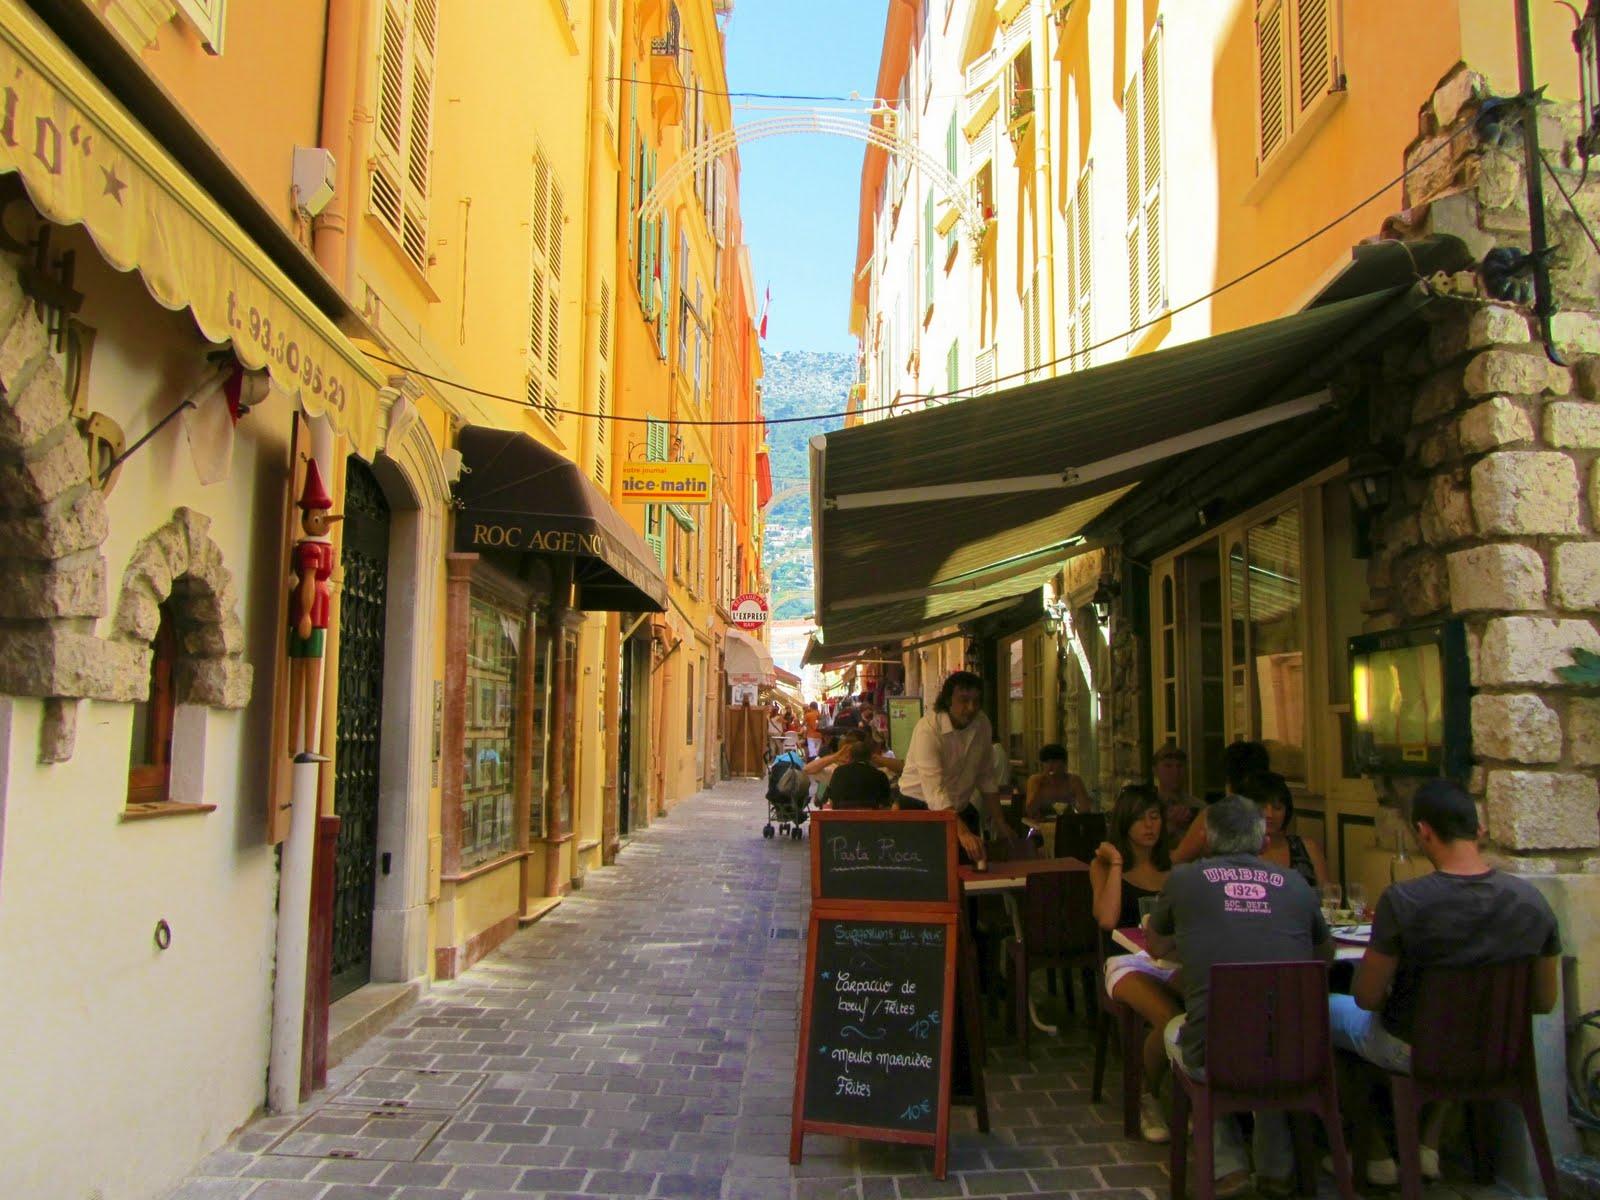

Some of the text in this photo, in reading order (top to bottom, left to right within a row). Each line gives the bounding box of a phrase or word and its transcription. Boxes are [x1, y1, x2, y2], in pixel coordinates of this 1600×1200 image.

[473, 524, 522, 548] ROC
[732, 612, 767, 620] L'EXPRESS
[827, 836, 869, 861] Pasta
[1203, 868, 1284, 887] UMBRO
[1232, 885, 1259, 896] 1924
[901, 980, 917, 994] de
